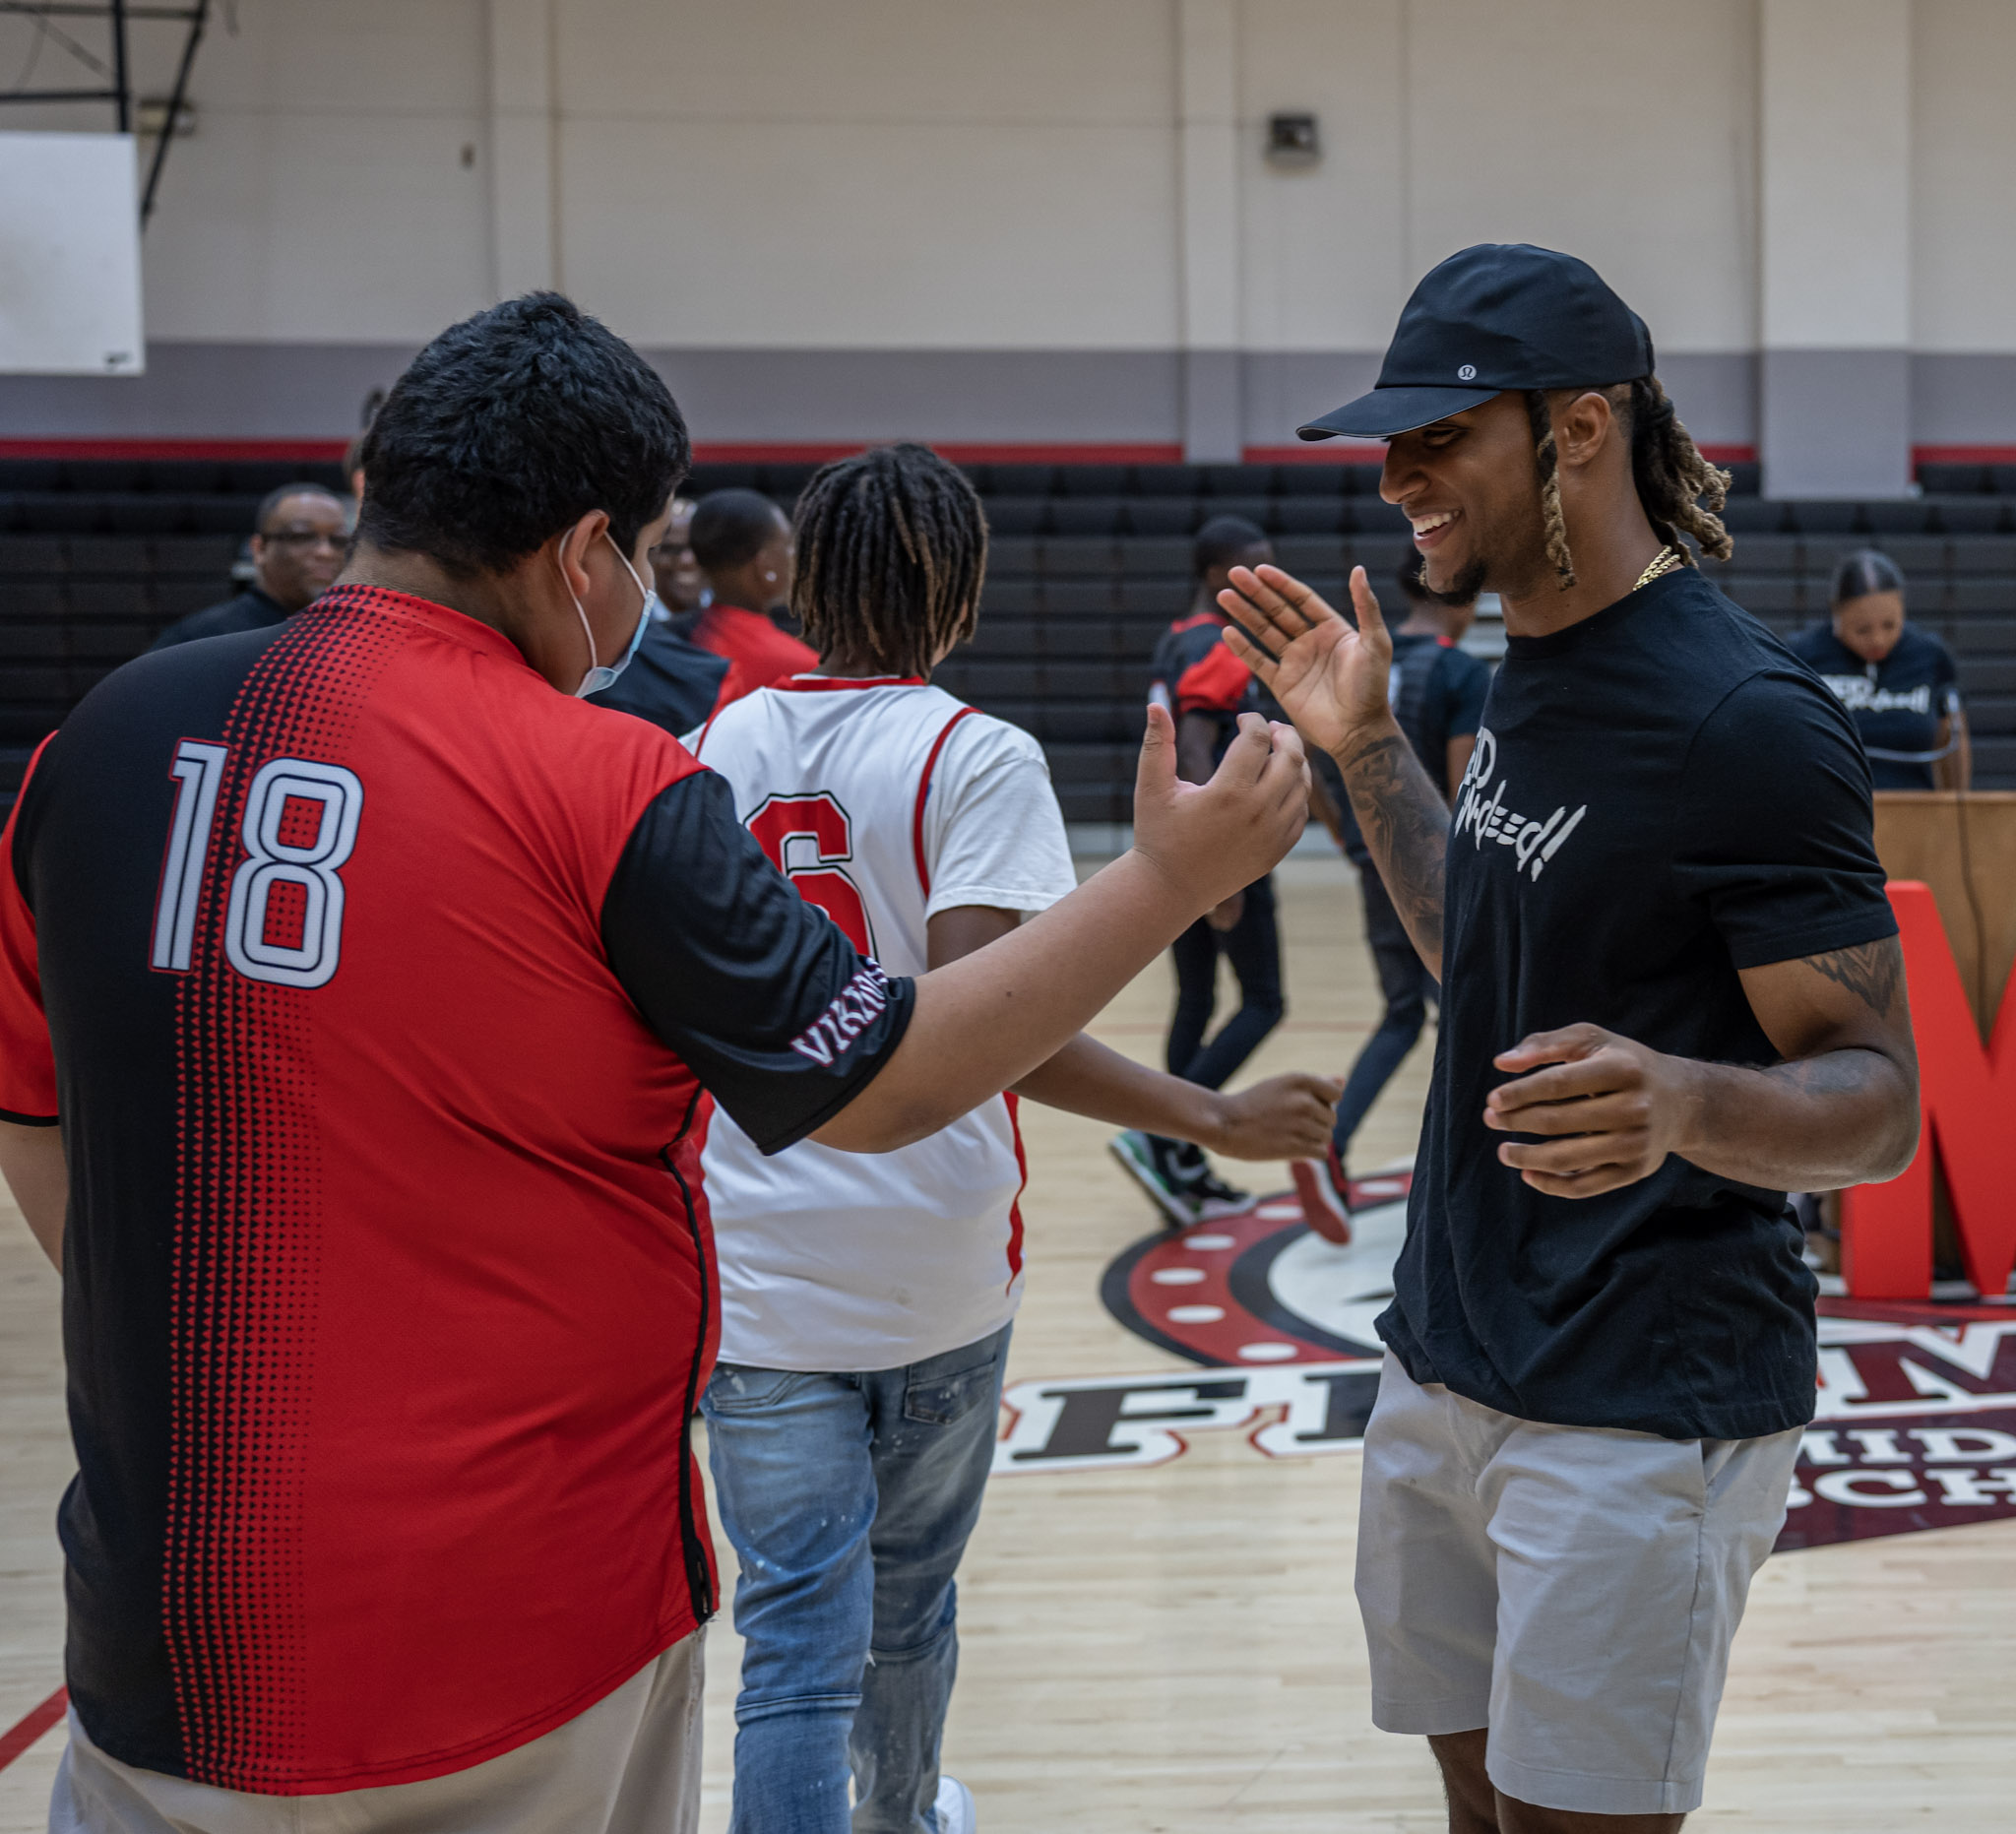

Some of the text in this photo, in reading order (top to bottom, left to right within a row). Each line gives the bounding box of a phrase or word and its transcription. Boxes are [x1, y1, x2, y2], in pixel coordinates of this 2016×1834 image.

[150, 736, 364, 990] 18
[743, 790, 881, 961] 6
[788, 954, 889, 1067] VIKIN
